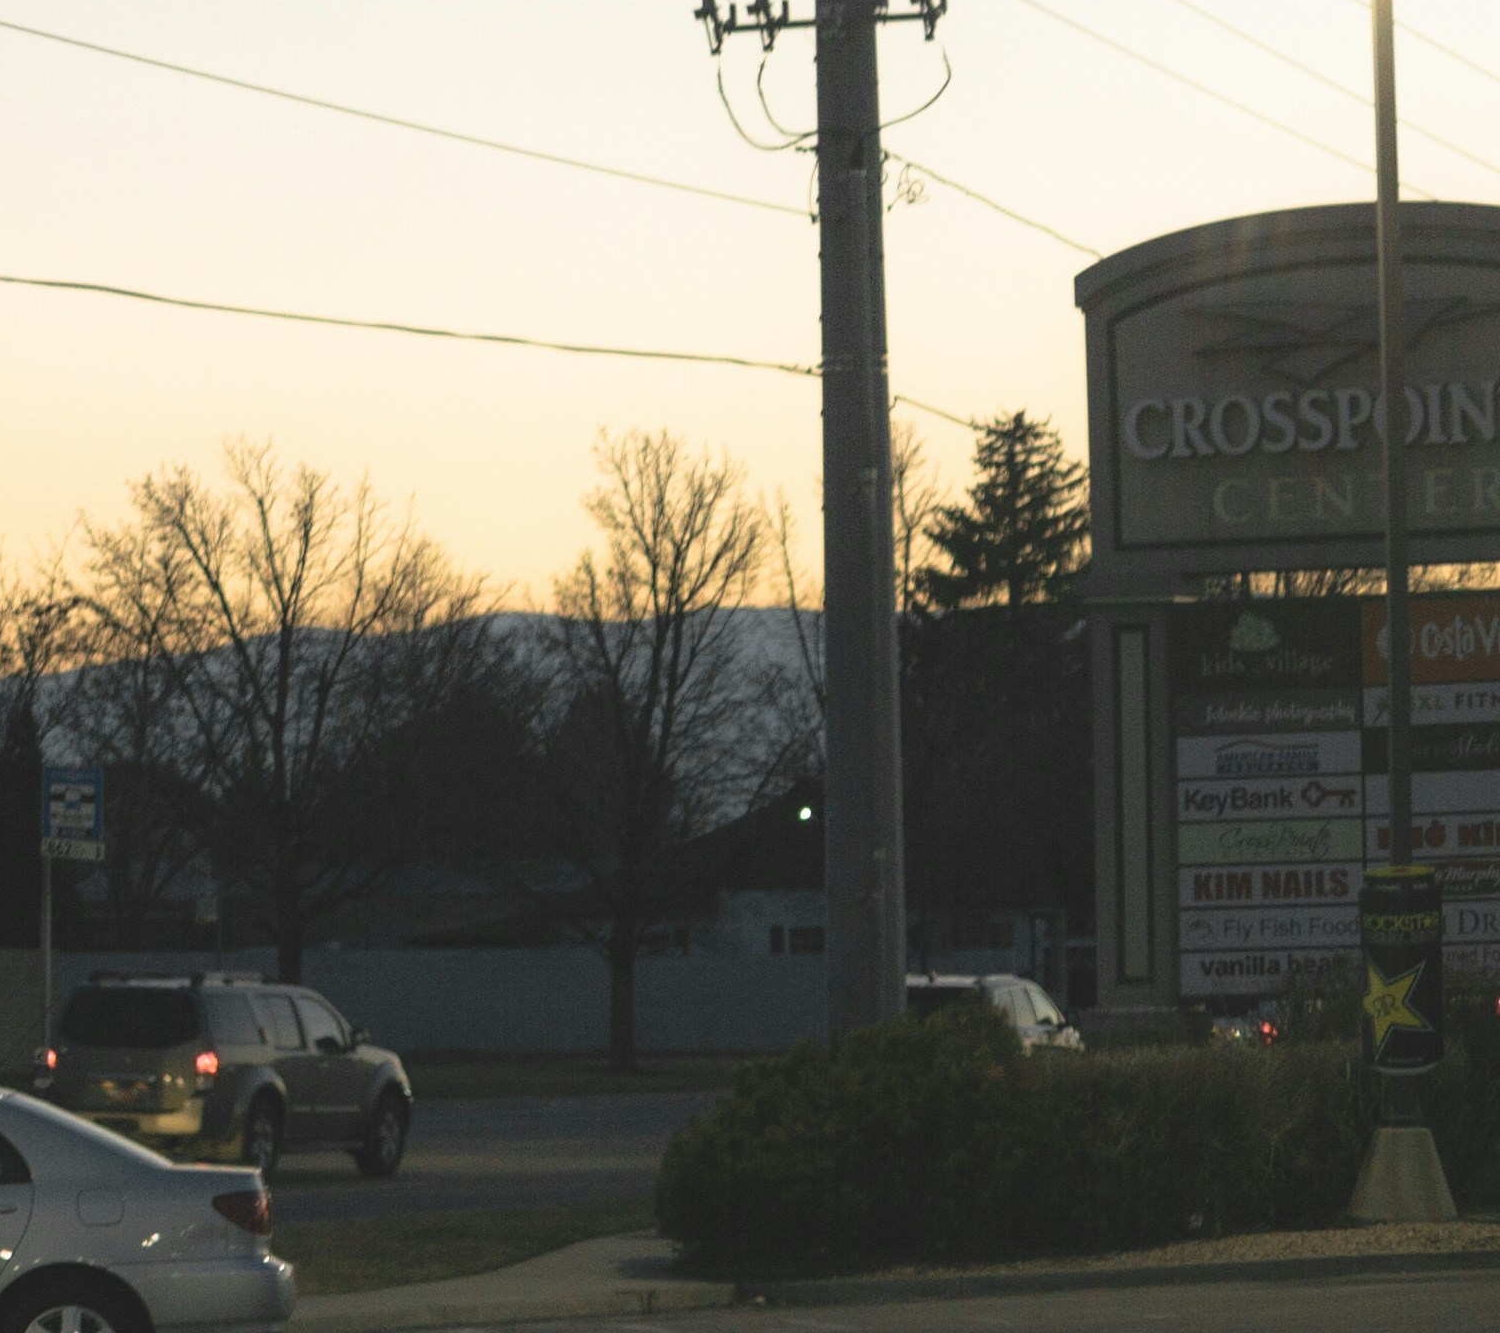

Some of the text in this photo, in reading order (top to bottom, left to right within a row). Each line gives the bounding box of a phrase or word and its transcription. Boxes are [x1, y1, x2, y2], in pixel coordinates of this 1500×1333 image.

[1213, 466, 1500, 524] CENER
[1476, 614, 1500, 657] V
[1183, 787, 1293, 818] KeyBank
[1193, 870, 1349, 901] KIM NAILS
[1223, 919, 1253, 942] Fly
[1260, 917, 1301, 937] Fish
[1200, 954, 1280, 976] vanilla
